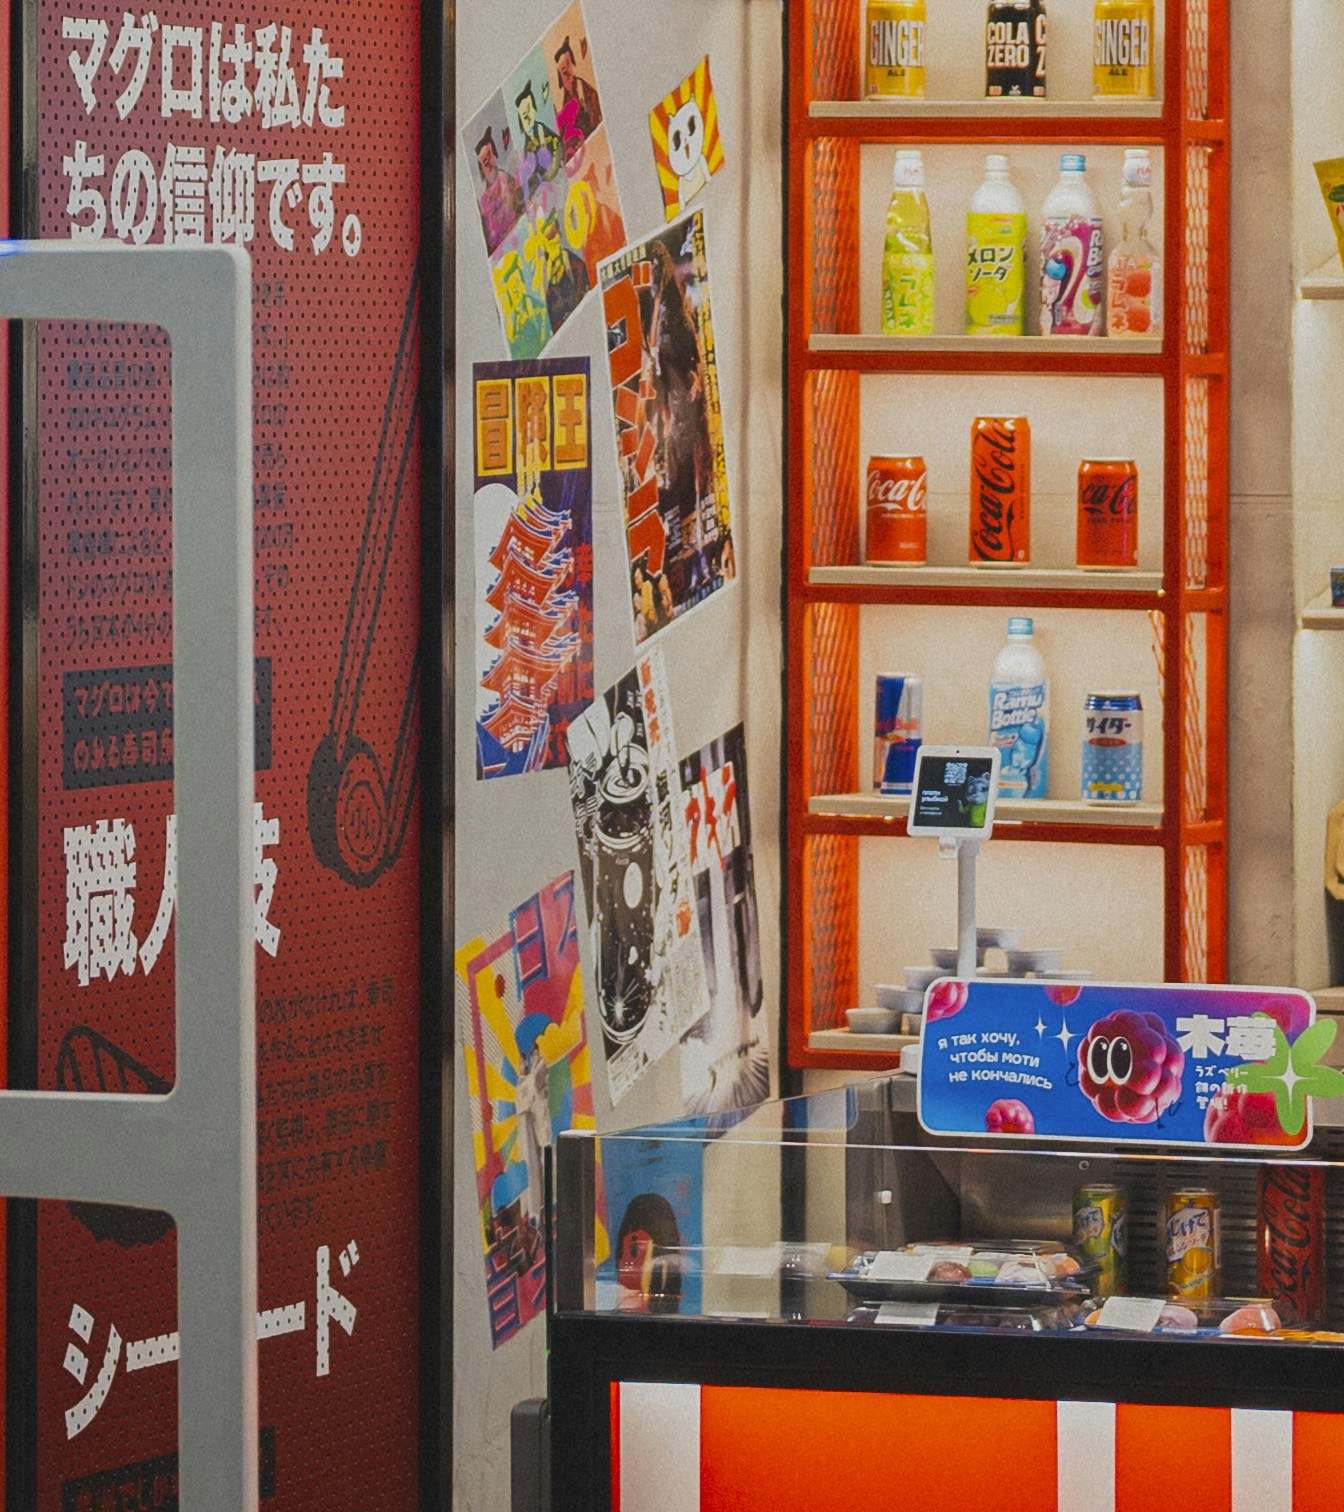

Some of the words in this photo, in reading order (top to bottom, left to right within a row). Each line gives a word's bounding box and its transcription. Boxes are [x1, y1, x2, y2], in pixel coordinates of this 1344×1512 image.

[987, 21, 1029, 46] COLA
[987, 45, 1030, 69] ZERO
[61, 11, 345, 130] マグロは私た
[62, 140, 363, 258] ちの信仰です。
[967, 245, 1016, 265] メロン
[949, 1047, 998, 1064] чтобы
[1002, 1053, 1040, 1068] моти
[948, 1070, 968, 1084] не
[971, 1068, 1053, 1090] кончались
